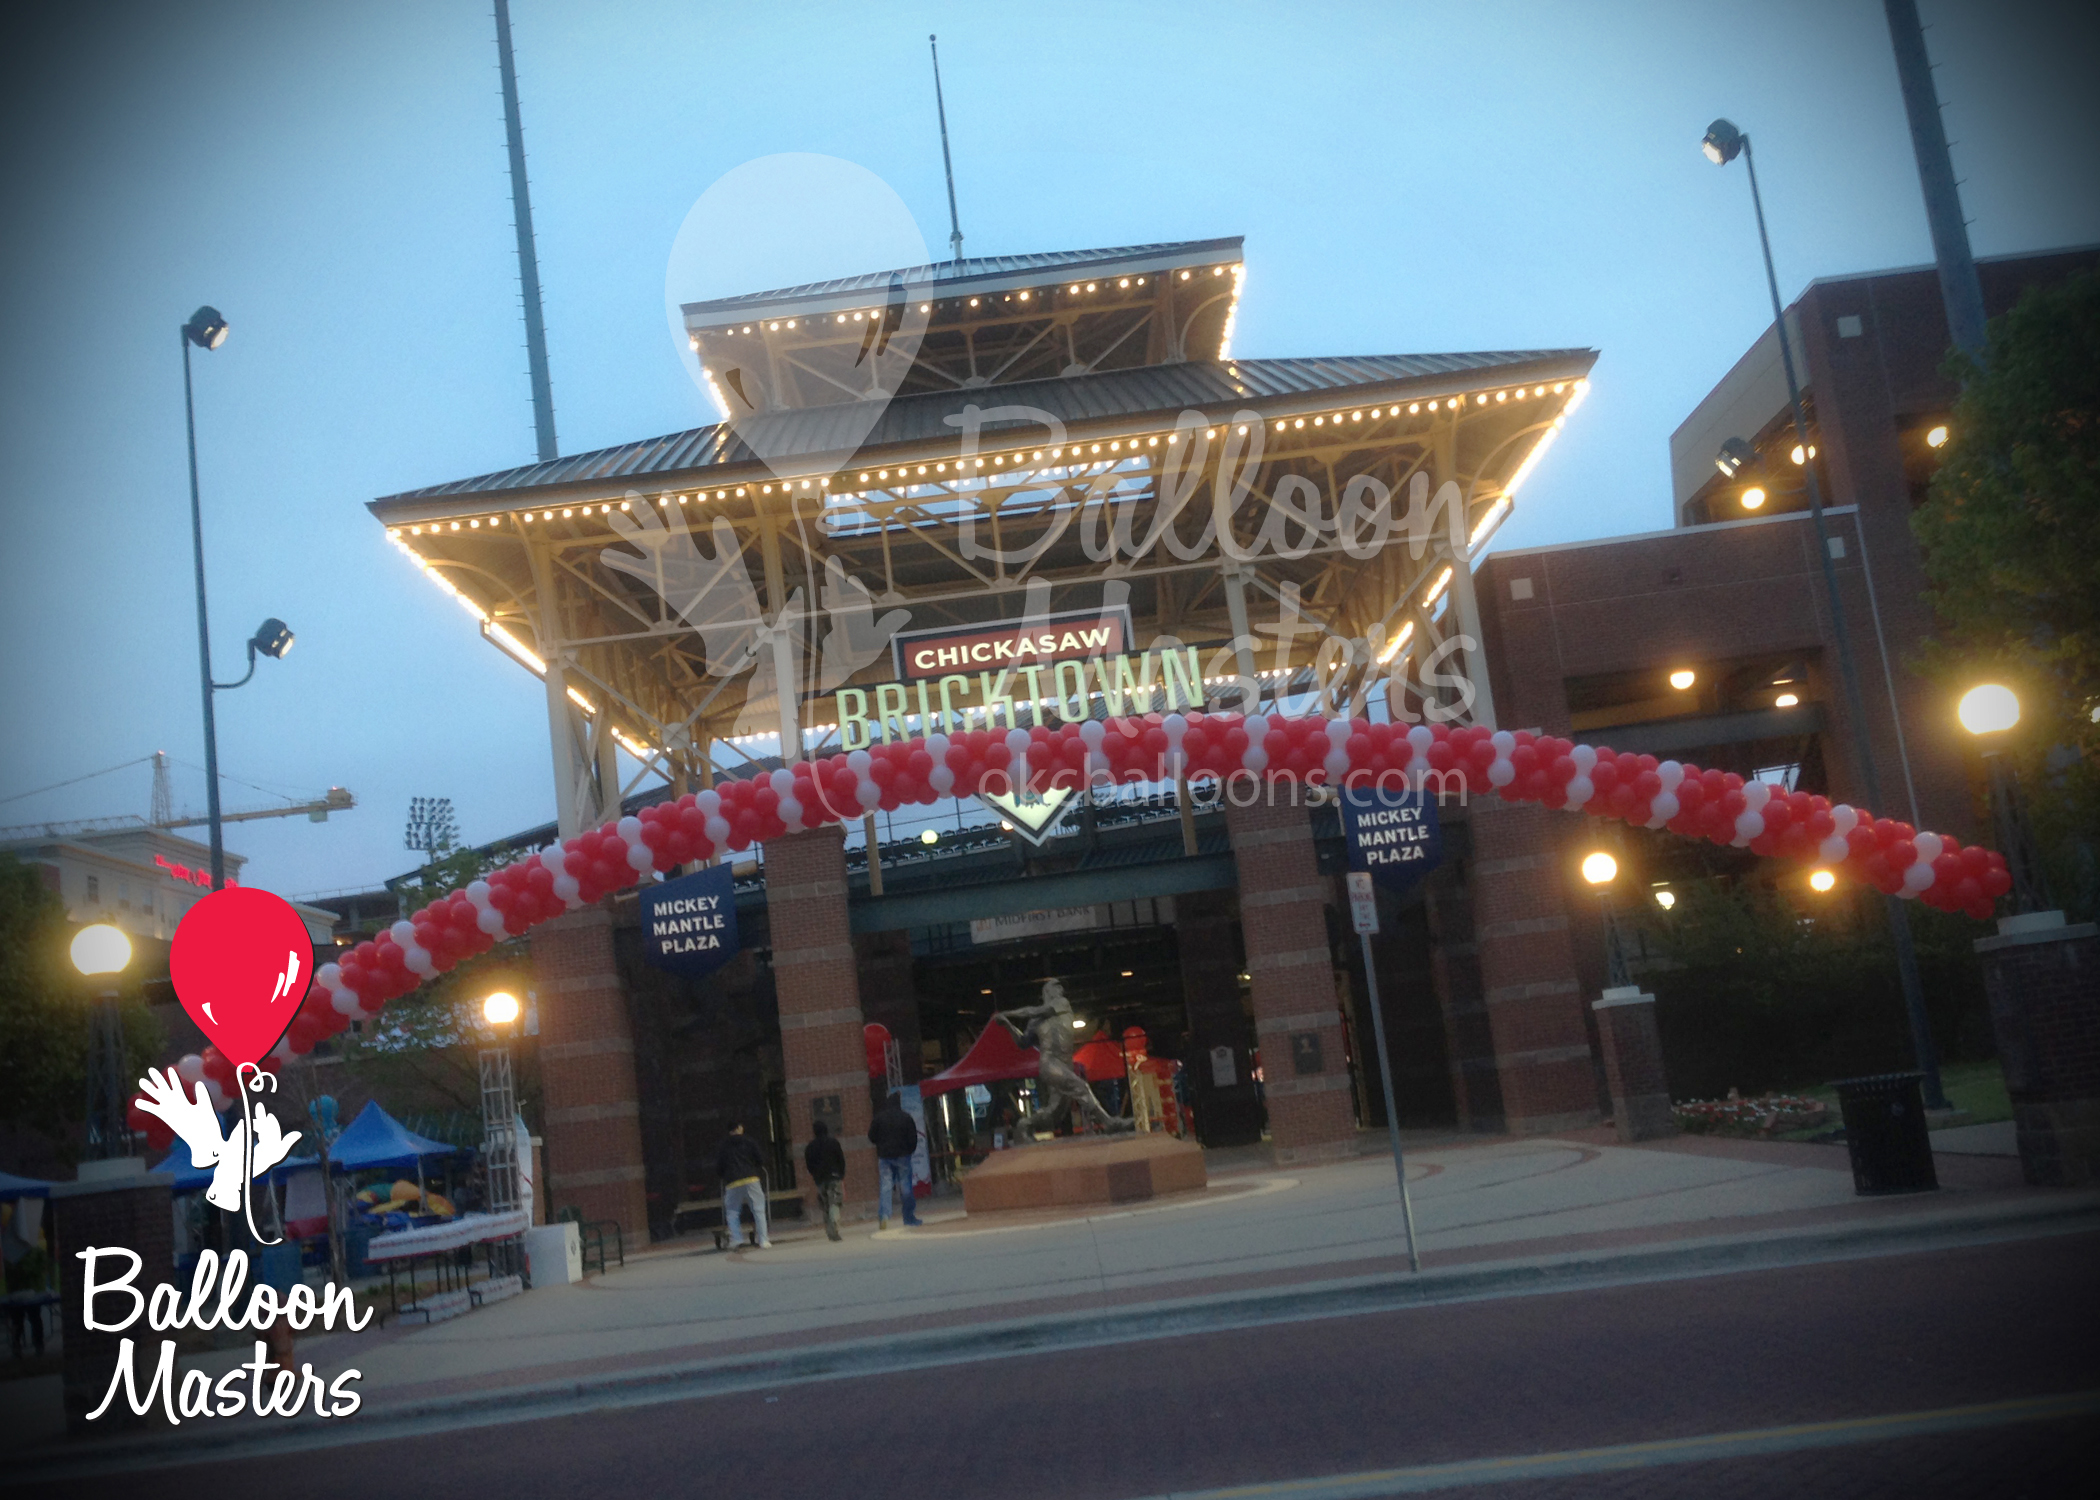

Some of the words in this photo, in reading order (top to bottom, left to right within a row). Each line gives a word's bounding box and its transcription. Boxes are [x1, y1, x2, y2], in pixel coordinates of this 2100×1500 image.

[914, 627, 1111, 669] CHICKASAW
[836, 646, 1204, 751] BRICKTOWN
[1357, 807, 1422, 827] MICKEY
[1358, 825, 1429, 847] MANTLE
[1366, 846, 1424, 865] PLAZA
[653, 895, 720, 916] MICKEY
[653, 914, 725, 936] MANTLE
[661, 934, 720, 954] PLAZA
